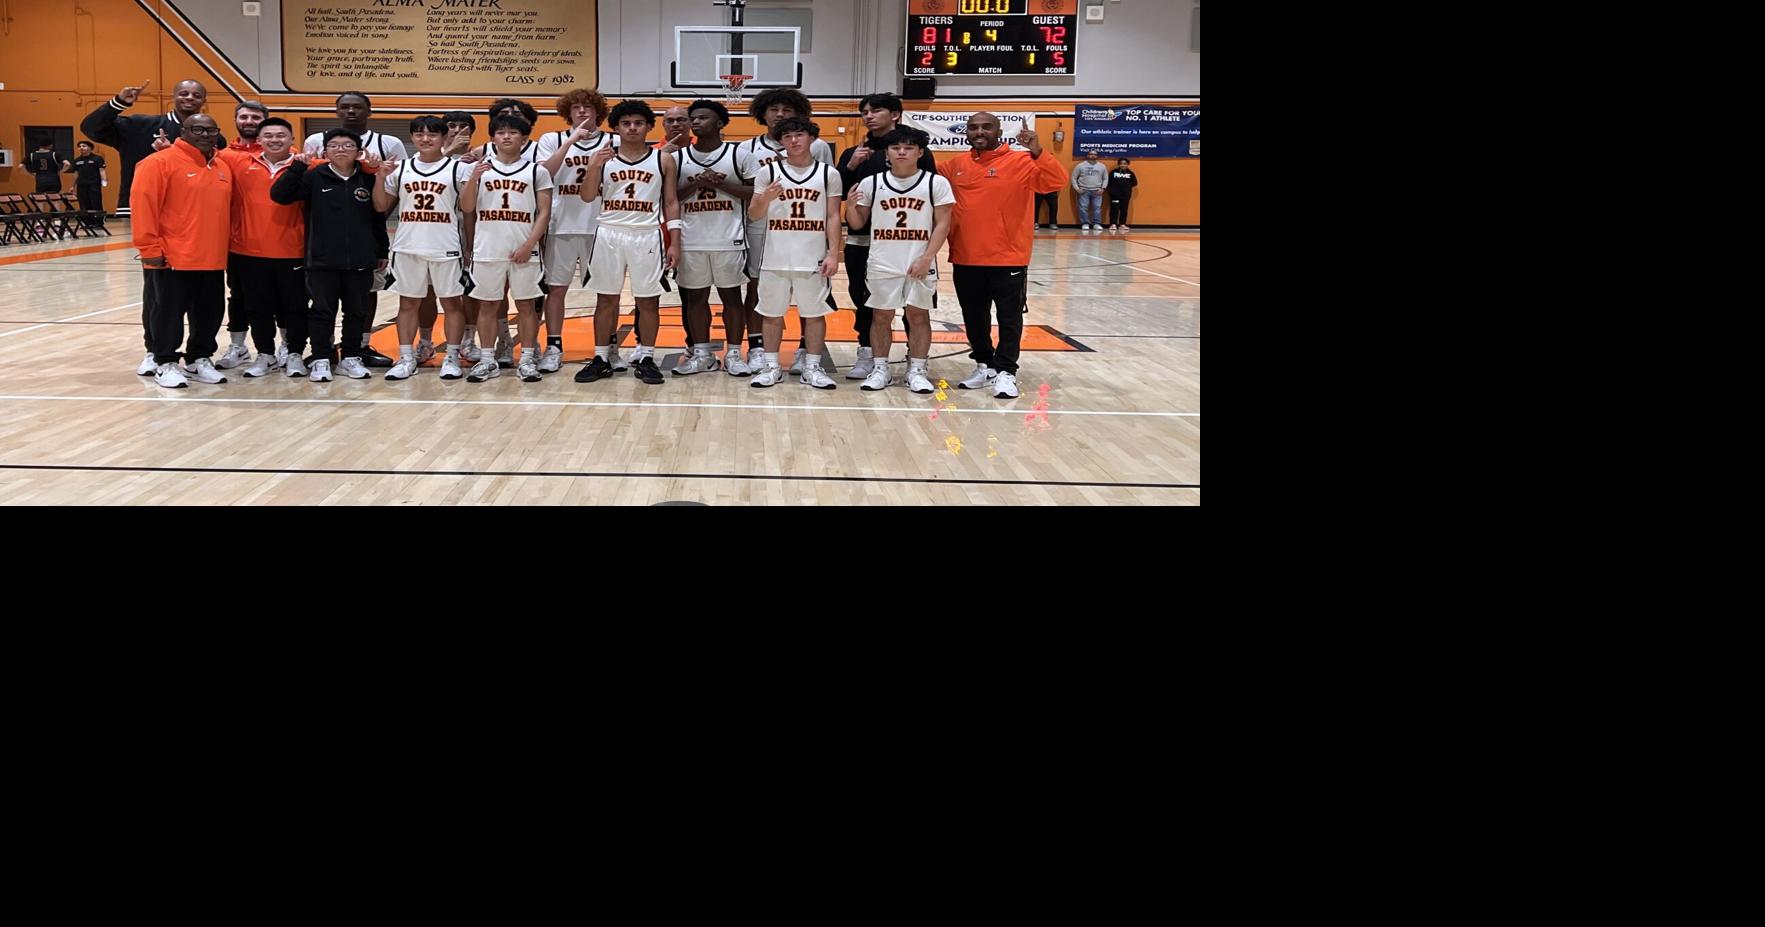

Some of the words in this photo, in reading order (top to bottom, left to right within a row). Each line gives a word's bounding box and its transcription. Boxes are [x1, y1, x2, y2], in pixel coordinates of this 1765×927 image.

[919, 16, 953, 25] TIGERS
[1032, 16, 1065, 25] GUEST
[923, 27, 951, 44] 81
[985, 29, 997, 42] 4
[1040, 26, 1066, 44] 72
[922, 52, 933, 66] 2
[946, 52, 958, 66] 3
[1029, 52, 1035, 65] 1
[1053, 51, 1065, 66] 5
[505, 75, 535, 84] CLASS
[537, 75, 549, 85] of
[552, 74, 575, 85] 1982
[564, 155, 590, 168] SOU
[575, 167, 587, 184] 2
[610, 169, 654, 184] SOUTH
[404, 180, 447, 195] SOUTH
[485, 179, 528, 194] SOUTH
[624, 182, 636, 199] 4
[413, 193, 435, 211] 32
[501, 192, 510, 209] 1
[779, 188, 821, 202] SOUTH
[604, 199, 654, 213] PASADENA
[684, 200, 734, 214] PASADENA
[790, 201, 806, 218] 11
[880, 197, 925, 211] SOUTH
[400, 211, 452, 224] PASADENA
[479, 210, 532, 224] PASADENA
[895, 211, 907, 228] 2
[769, 219, 825, 232] PASADENA
[873, 229, 929, 241] PASADENA
